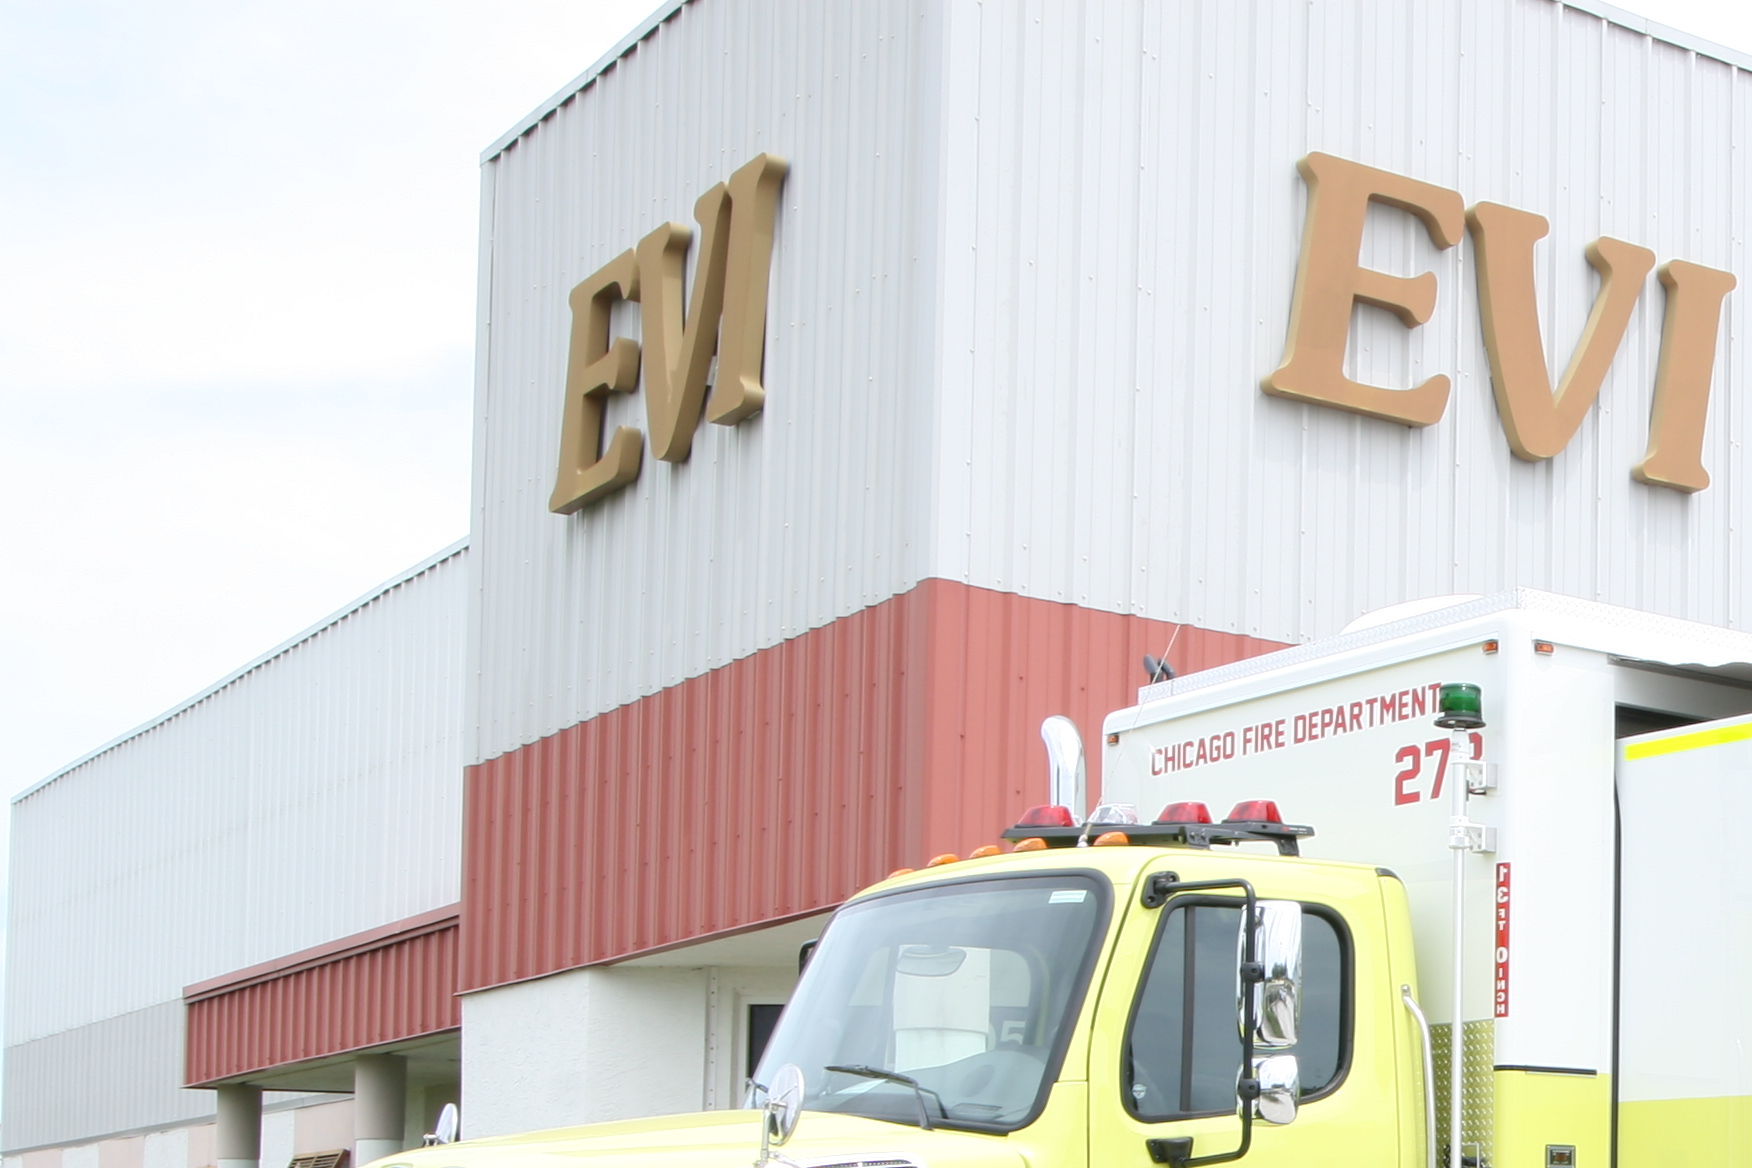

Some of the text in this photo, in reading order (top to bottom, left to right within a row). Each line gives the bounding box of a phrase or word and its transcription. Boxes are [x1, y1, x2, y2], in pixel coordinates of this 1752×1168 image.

[549, 152, 790, 514] EVI
[1260, 151, 1737, 493] EVI
[1150, 682, 1442, 777] CHICAGO FIRE DEPARTMENT
